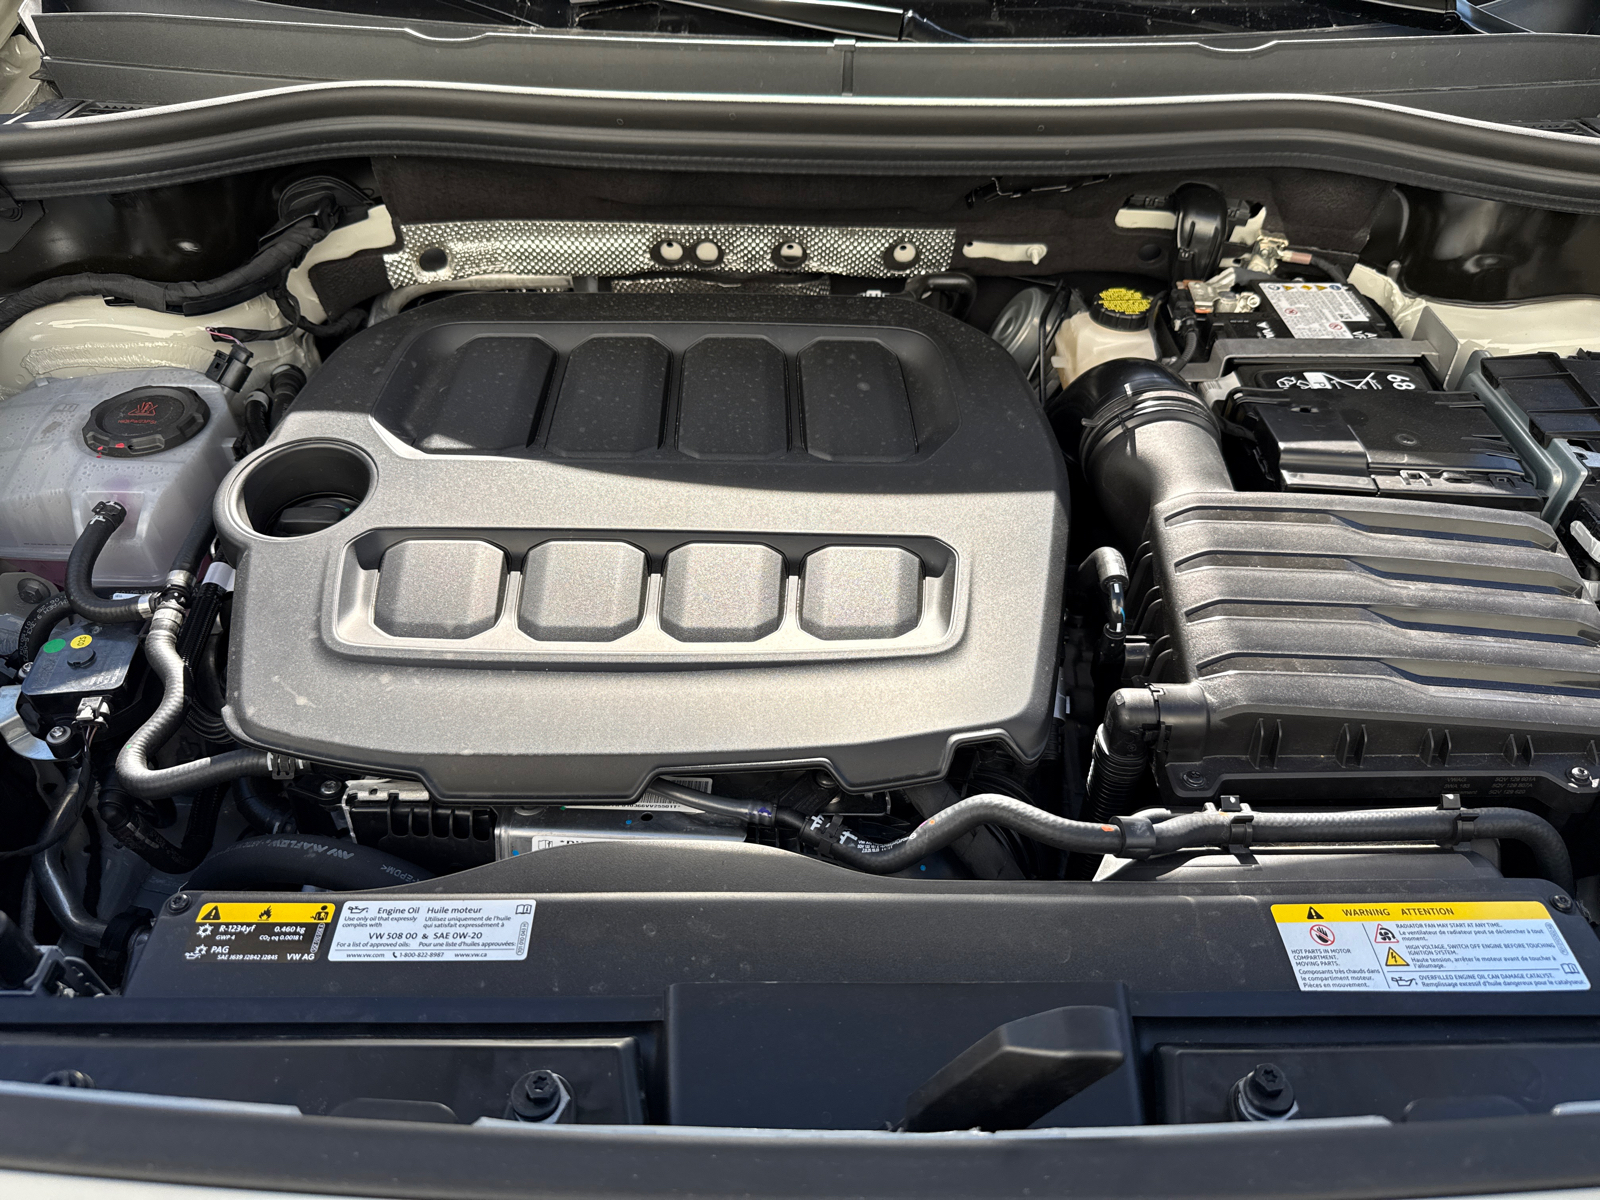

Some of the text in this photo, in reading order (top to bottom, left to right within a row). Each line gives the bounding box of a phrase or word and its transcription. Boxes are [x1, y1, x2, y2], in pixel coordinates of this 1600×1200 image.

[1387, 374, 1416, 390] 68
[377, 907, 406, 916] Engine
[1401, 908, 1455, 916] ATTENTION
[219, 924, 256, 934] R-1234yf
[296, 926, 306, 934] kg
[368, 932, 385, 940] VW
[386, 932, 403, 940] 508
[405, 932, 418, 940] 00
[211, 946, 230, 954] PAG
